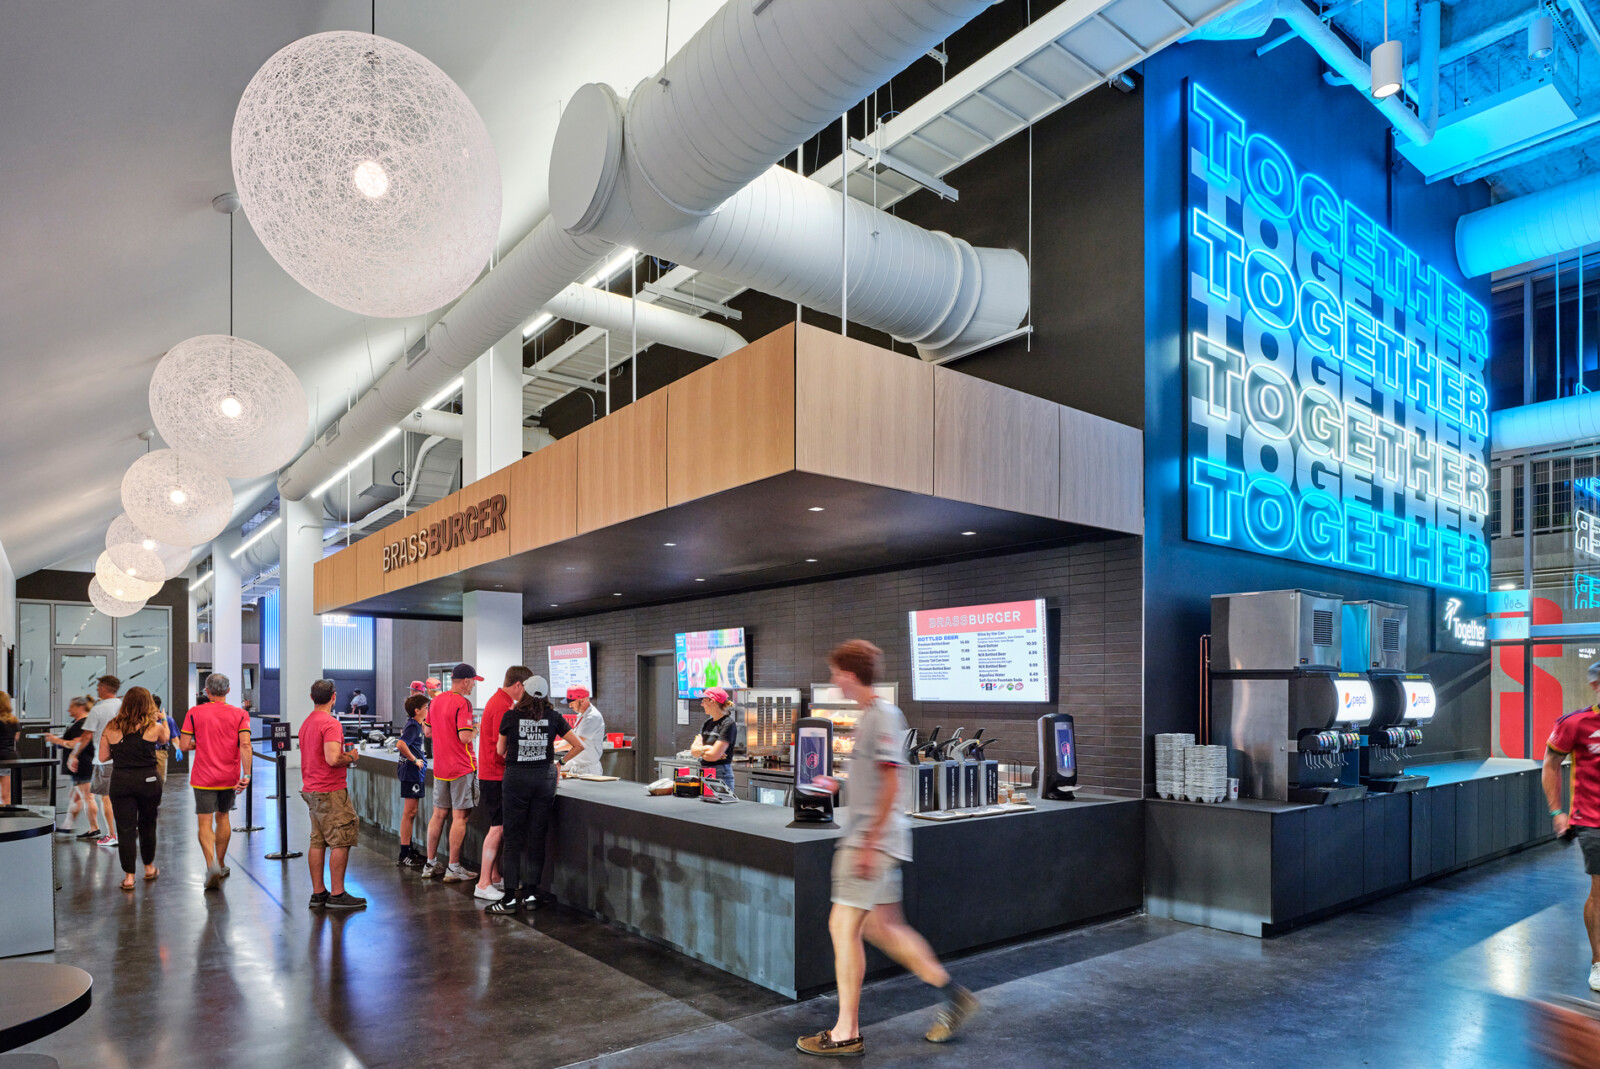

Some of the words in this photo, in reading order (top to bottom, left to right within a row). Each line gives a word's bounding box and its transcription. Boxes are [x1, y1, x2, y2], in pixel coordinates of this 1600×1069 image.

[1193, 82, 1489, 359] TOGETHER
[1193, 207, 1489, 437] TOGETHER
[1193, 332, 1489, 515] TOGETHER
[383, 494, 507, 573] BRASSBURGER
[1193, 457, 1489, 593] TOGETHER
[928, 611, 1021, 629] BRASSBURGER
[1453, 617, 1486, 641] Together
[1352, 694, 1366, 707] pepsi
[1417, 694, 1430, 706] pepsi
